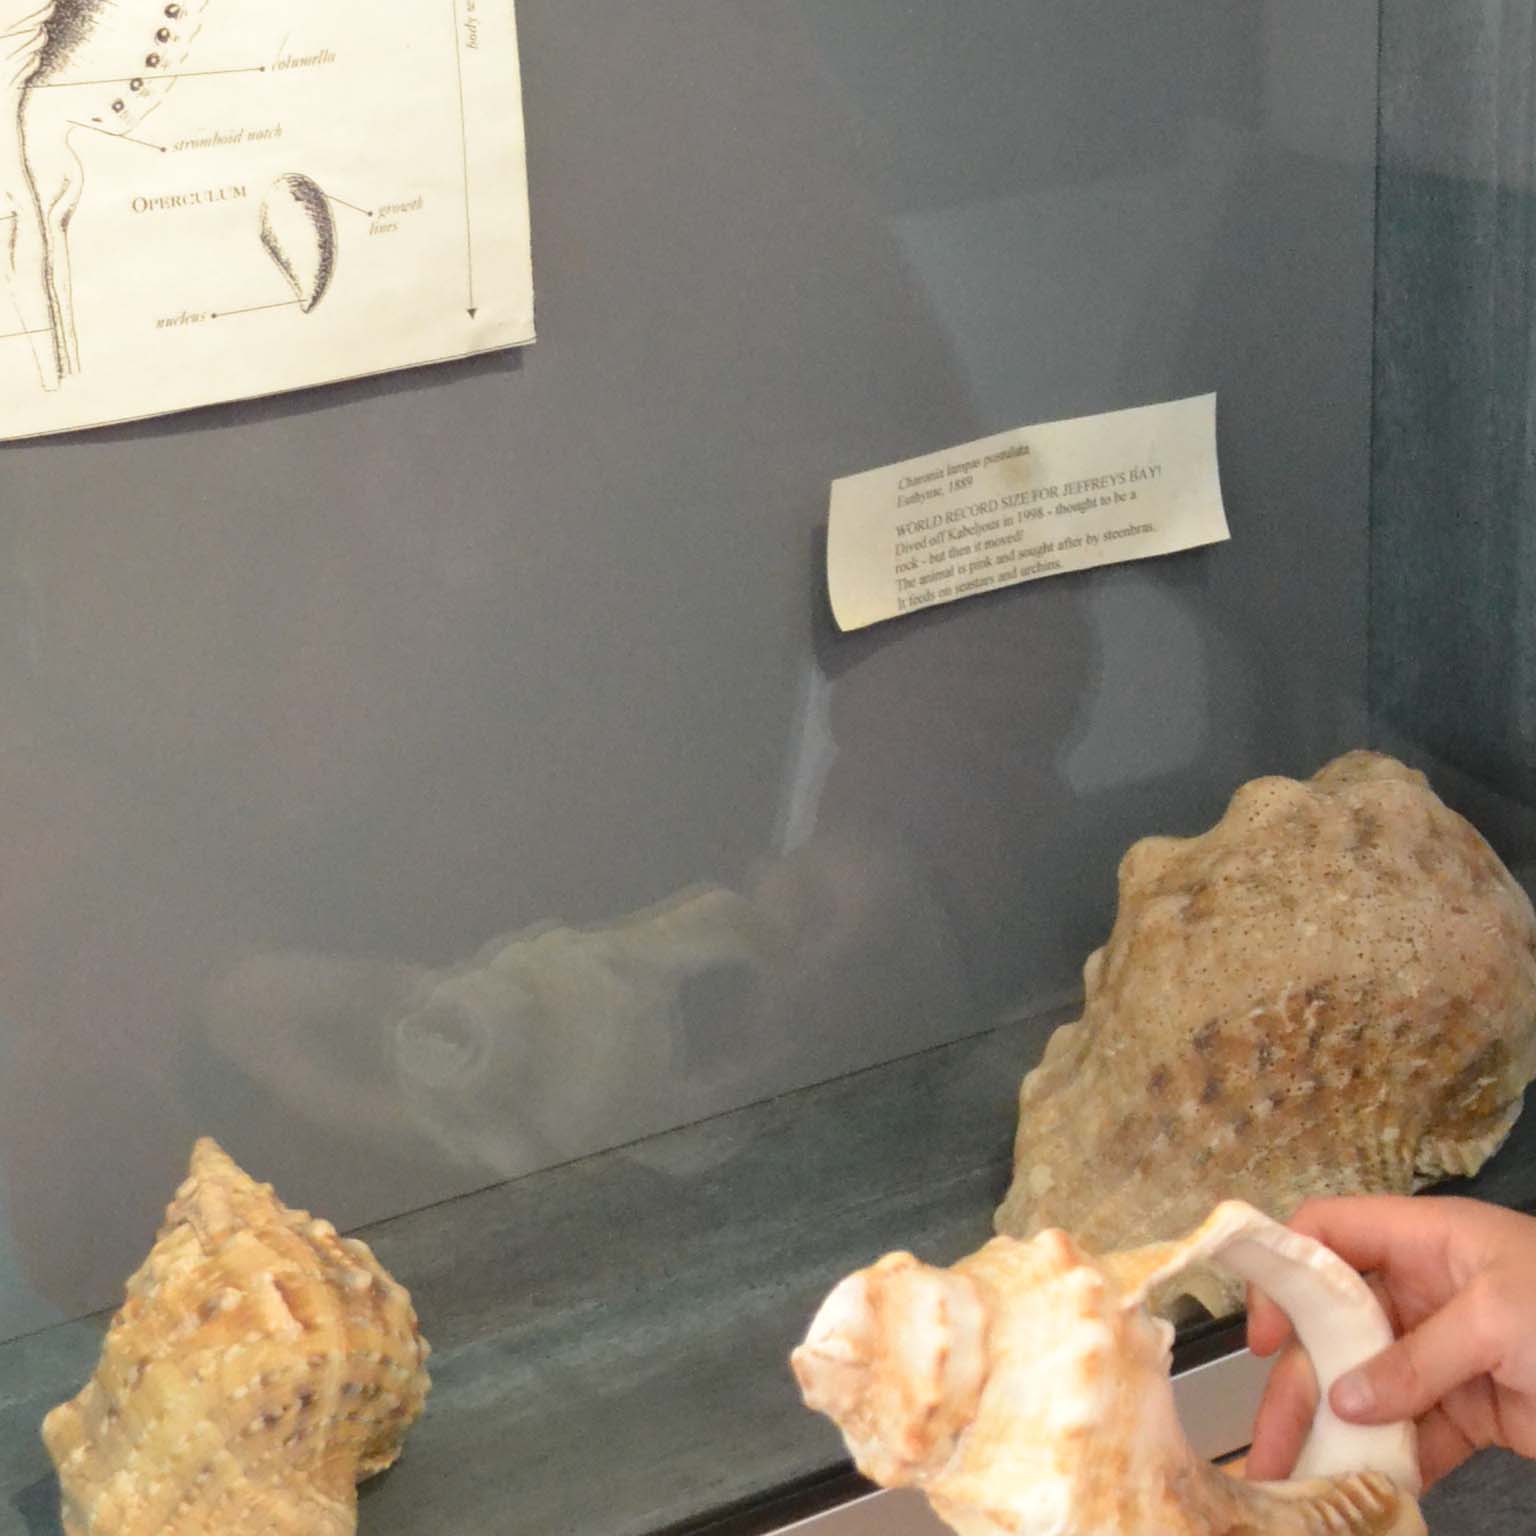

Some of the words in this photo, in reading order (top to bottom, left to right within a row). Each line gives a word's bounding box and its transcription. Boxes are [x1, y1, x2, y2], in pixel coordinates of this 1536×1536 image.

[466, 13, 480, 50] body
[271, 48, 336, 72] columella
[172, 129, 242, 153] stromboid
[247, 122, 283, 141] notch
[368, 220, 399, 237] lines
[155, 309, 207, 329] nucleus
[896, 514, 943, 536] WORLD
[945, 501, 999, 525] RECORD
[1000, 493, 1030, 511] SIZE
[1032, 486, 1059, 504] FOR
[1062, 471, 1126, 496] JEFFREYS
[1129, 464, 1162, 482] BAY!
[895, 536, 927, 556] Dived
[928, 531, 946, 547] off
[1002, 516, 1014, 529] in
[1017, 507, 1043, 525] 1998
[1055, 497, 1098, 517] thought
[1100, 496, 1112, 508] to
[1114, 491, 1127, 505] be
[1129, 492, 1137, 501] a
[895, 554, 919, 573] rock
[929, 548, 945, 563] but
[948, 544, 972, 559] then
[974, 540, 982, 553] it
[897, 577, 917, 592] The
[919, 565, 955, 586] animal
[958, 563, 967, 576] is
[969, 554, 993, 576] pink
[995, 548, 1016, 565] and
[1018, 540, 1054, 559] sought
[1057, 536, 1083, 551] after
[1085, 532, 1100, 547] by
[898, 597, 907, 610] It
[908, 589, 936, 607] feeds
[938, 588, 952, 599] on
[955, 577, 995, 595] seastars
[998, 567, 1017, 583] and
[1020, 559, 1063, 577] urchins.
